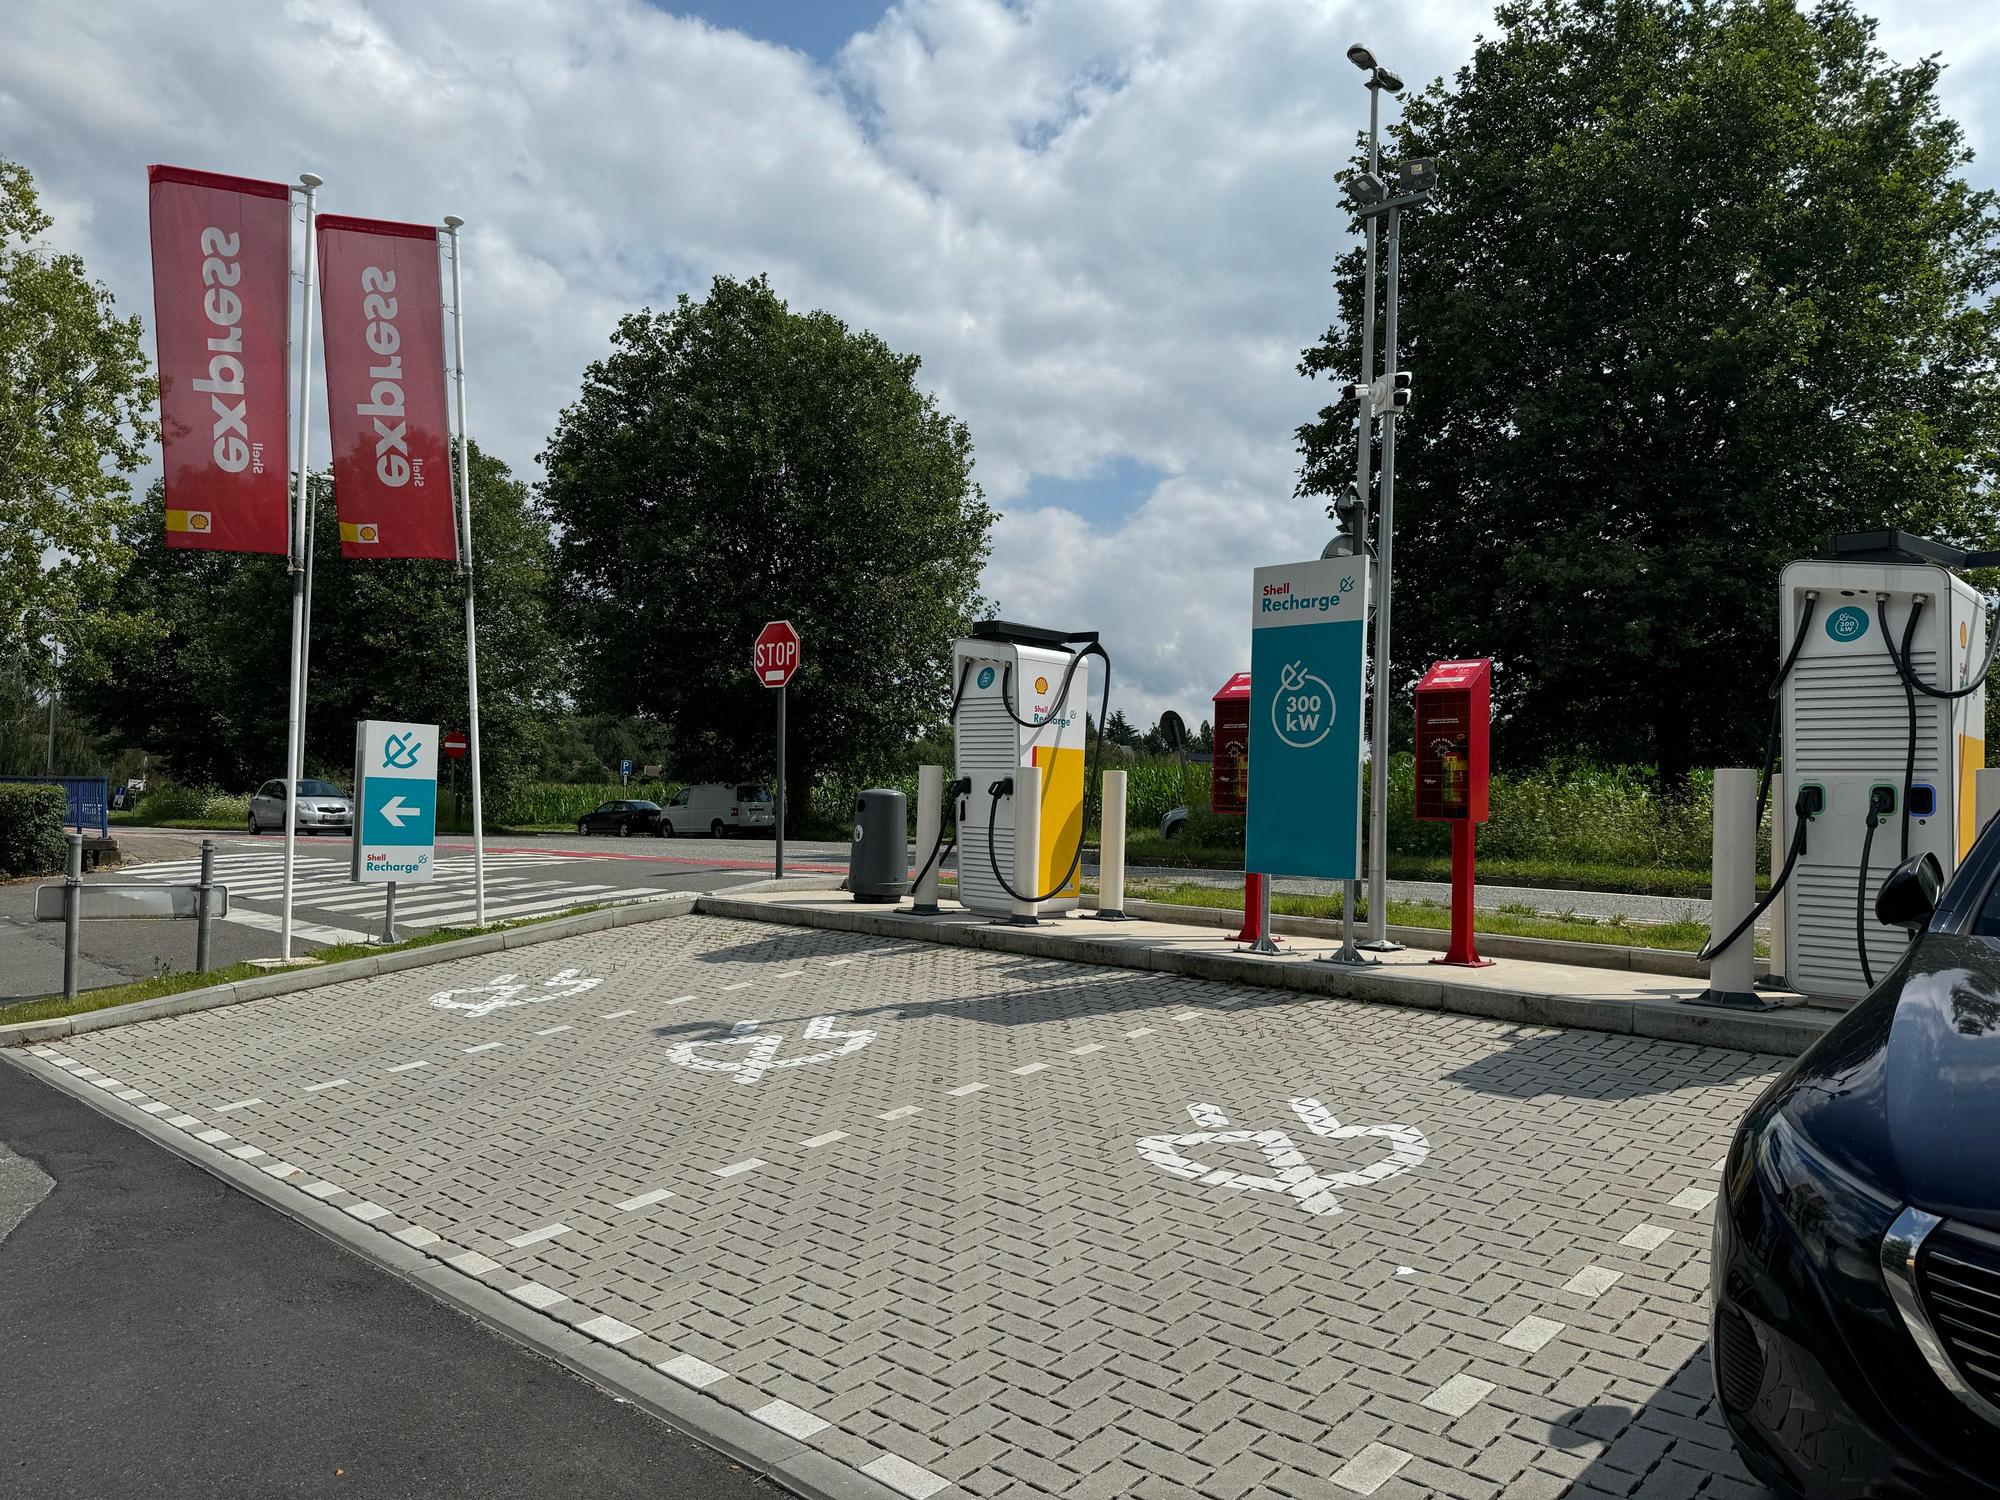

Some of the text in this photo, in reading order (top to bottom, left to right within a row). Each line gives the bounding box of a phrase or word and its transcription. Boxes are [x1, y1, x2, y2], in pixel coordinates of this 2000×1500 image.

[1263, 582, 1290, 596] Shell
[1262, 594, 1341, 612] Recharge
[756, 641, 796, 668] STOP
[1034, 705, 1049, 713] Shell
[1286, 695, 1321, 713] 300
[1033, 713, 1071, 728] Rearge
[1286, 714, 1320, 732] kW
[623, 761, 629, 771] P
[367, 854, 386, 862] Shell
[366, 861, 419, 873] Recharge
